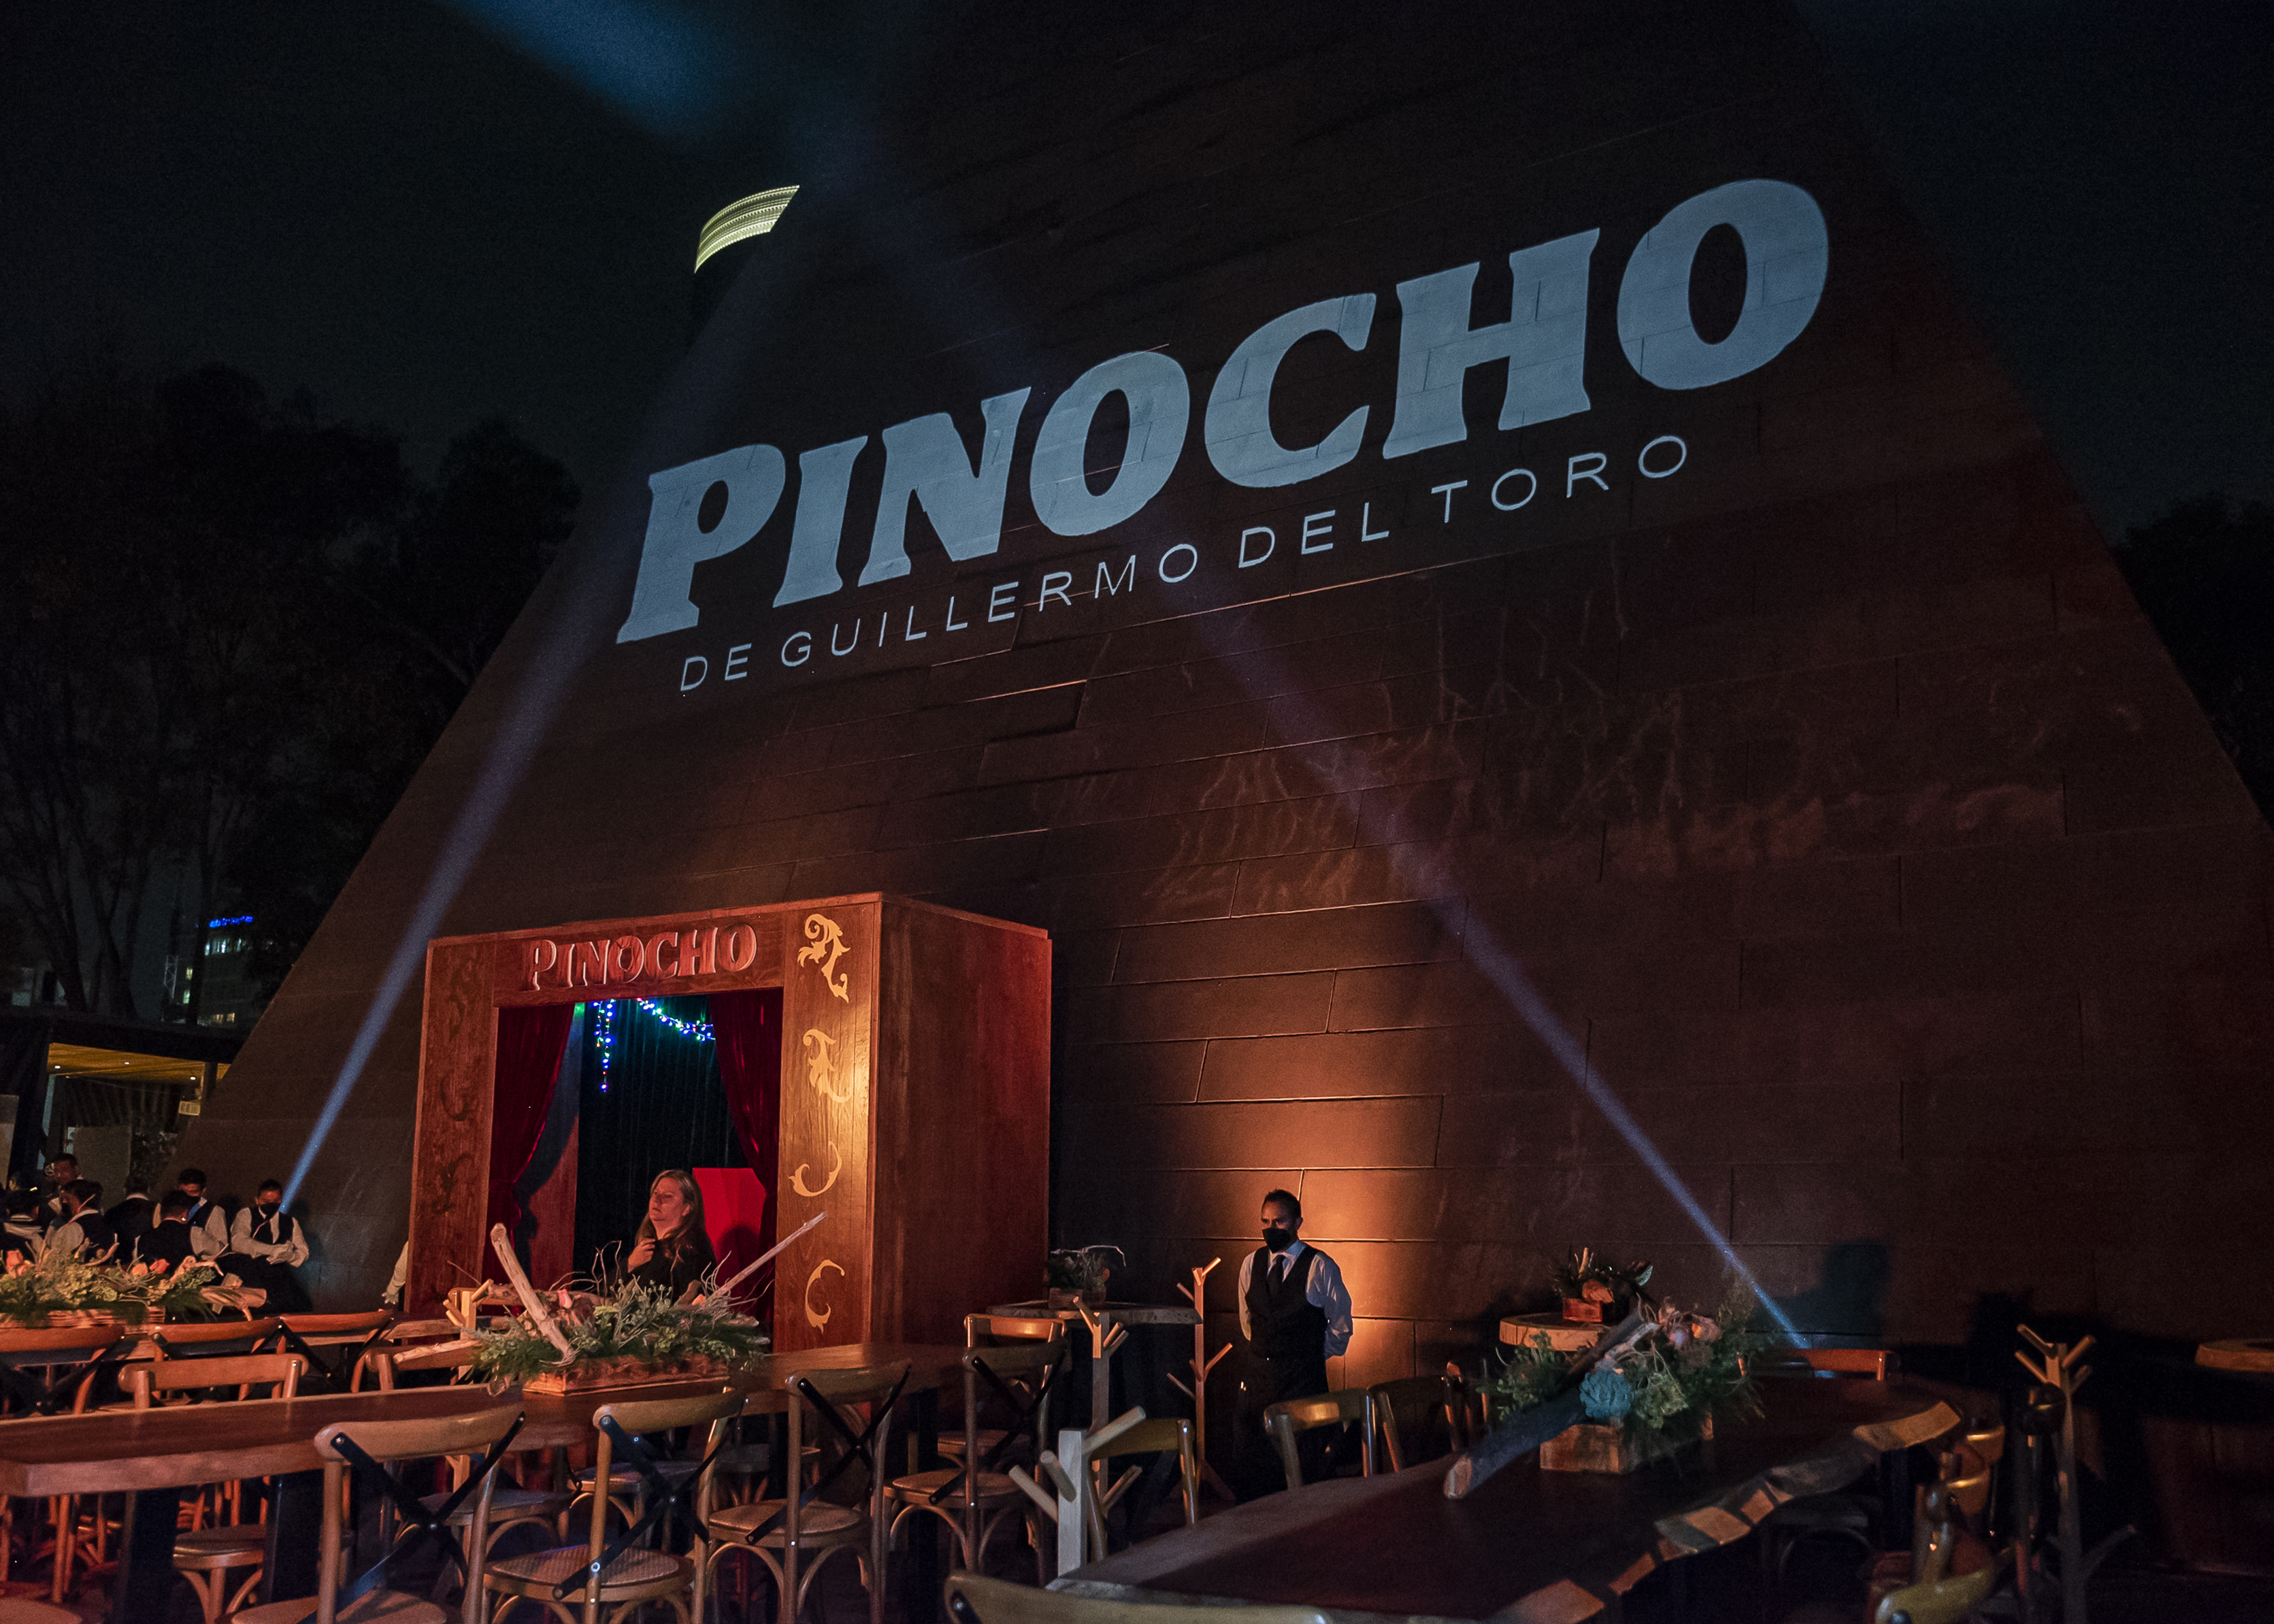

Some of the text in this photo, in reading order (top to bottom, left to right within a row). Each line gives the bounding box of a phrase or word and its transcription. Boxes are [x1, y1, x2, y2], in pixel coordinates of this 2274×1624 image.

[616, 179, 1828, 644] PINOCHO
[680, 434, 1688, 693] DE GUILLERMO DEL TORO
[521, 923, 758, 991] PINOCHO
